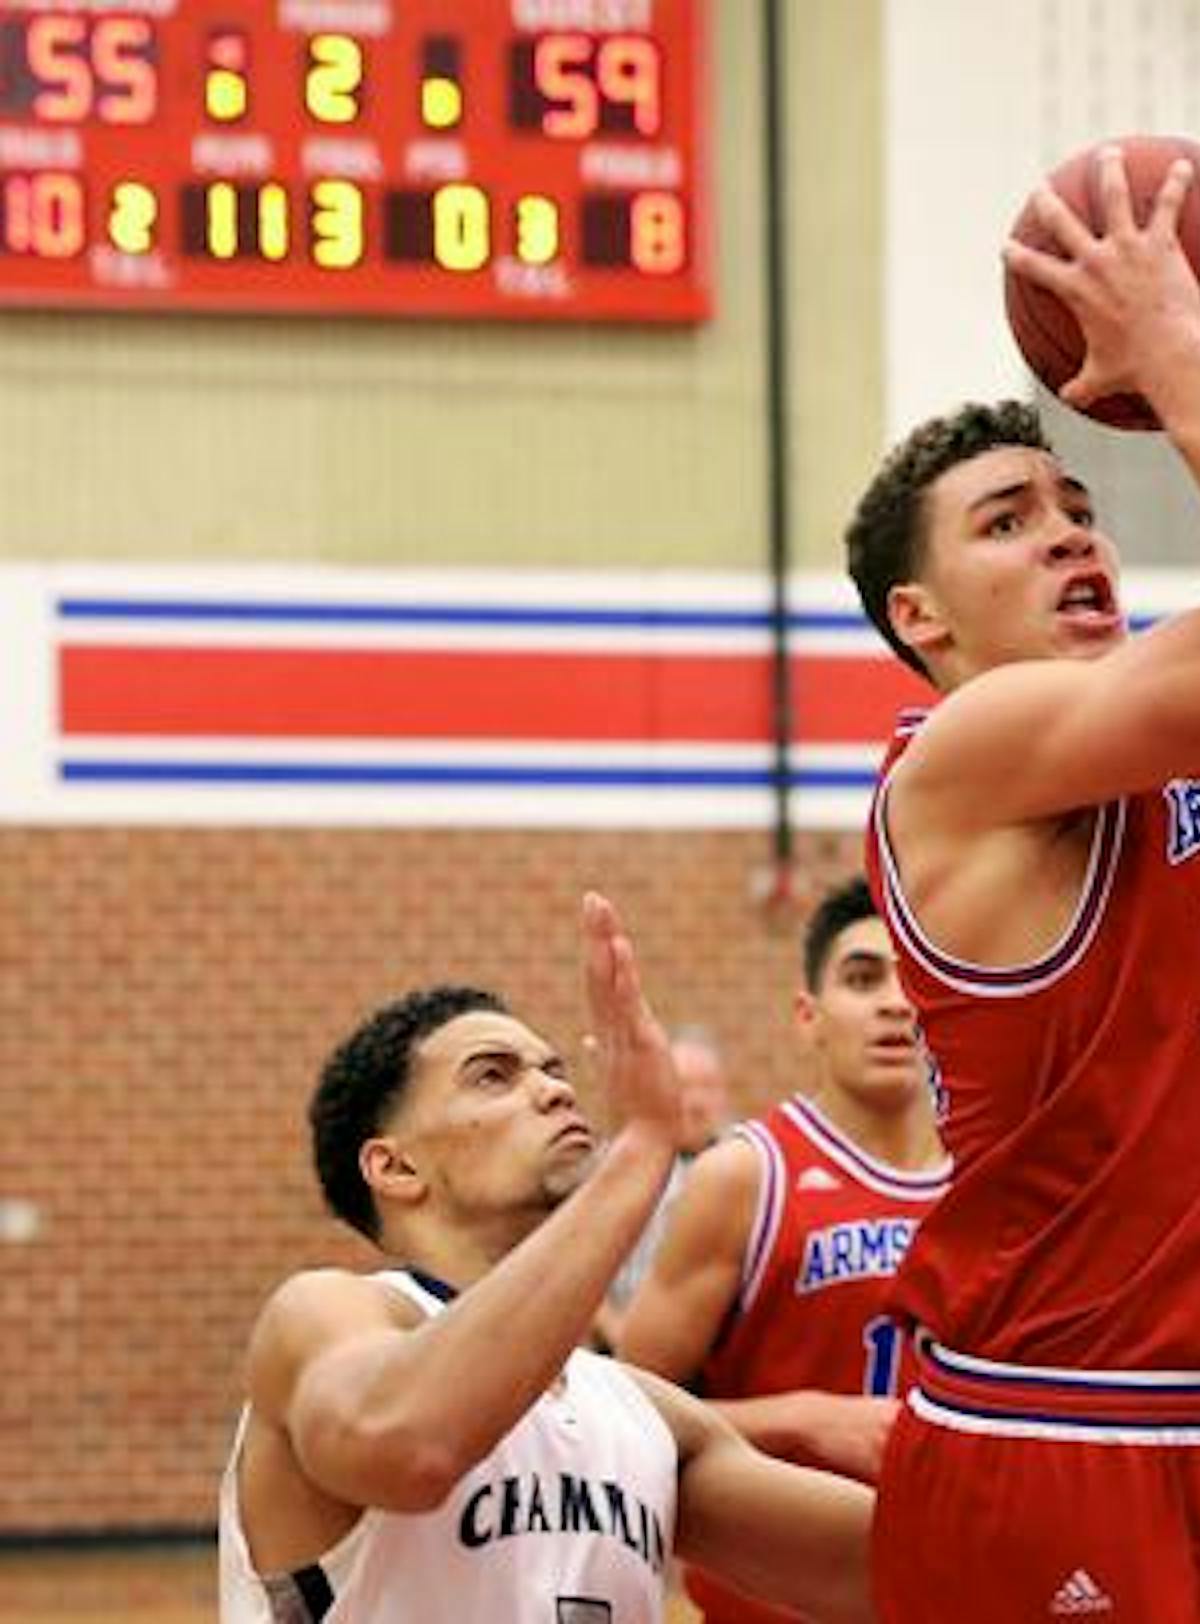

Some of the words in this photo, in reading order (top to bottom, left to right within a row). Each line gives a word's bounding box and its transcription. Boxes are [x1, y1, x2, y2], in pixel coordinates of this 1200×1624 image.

[27, 16, 157, 123] 55
[306, 34, 362, 123] 2
[535, 33, 661, 138] 59
[5, 173, 84, 257] 10
[630, 191, 685, 275] 8
